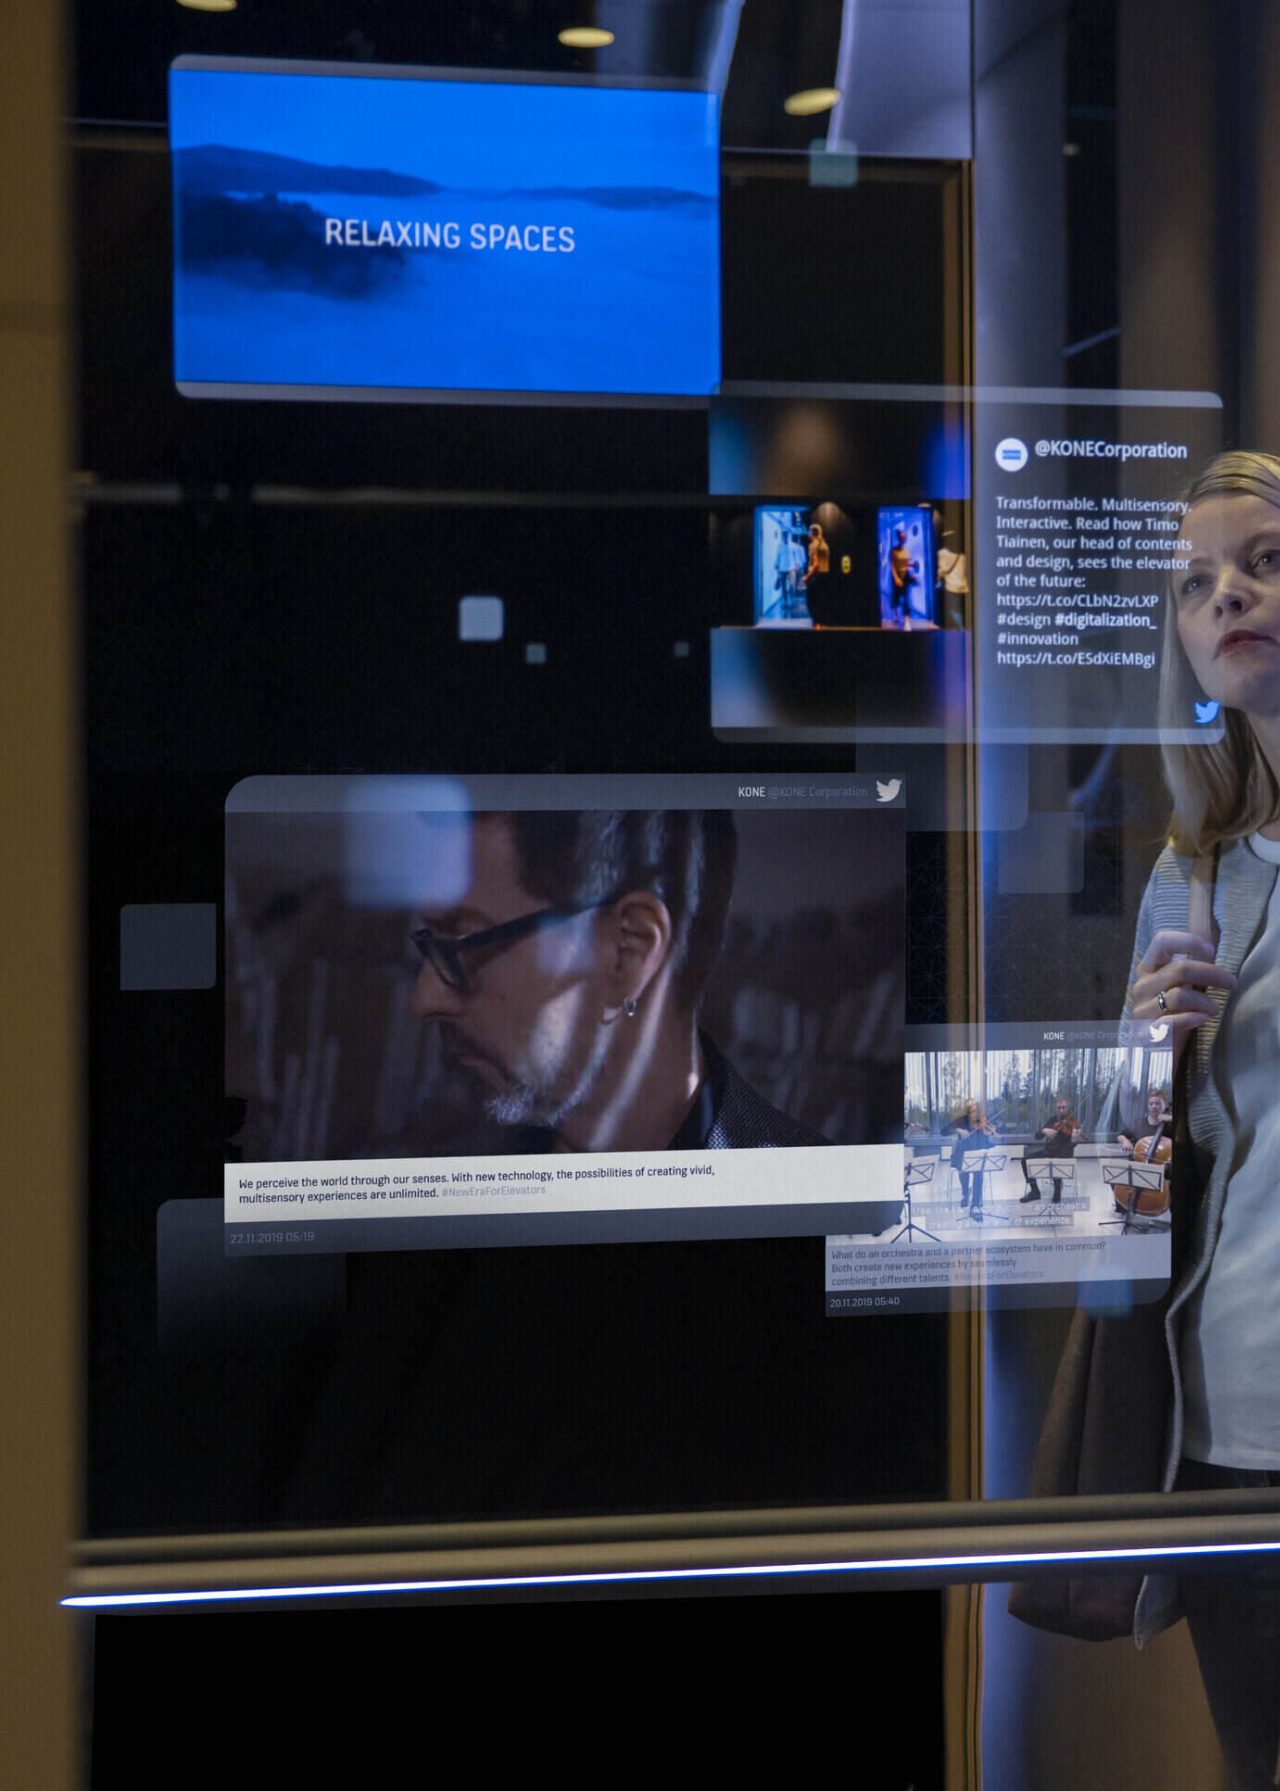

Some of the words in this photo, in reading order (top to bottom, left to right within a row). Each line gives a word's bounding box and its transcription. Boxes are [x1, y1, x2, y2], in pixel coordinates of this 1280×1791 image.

[325, 218, 461, 248] RELAXING
[469, 223, 576, 253] SPACES
[1034, 440, 1188, 461] @KONECorporation
[996, 496, 1098, 511] Transformable.
[1102, 498, 1192, 515] Multisensory.
[996, 516, 1073, 530] Interactive.
[1076, 517, 1110, 530] Read
[1113, 517, 1142, 531] how
[1145, 518, 1179, 531] Timo
[996, 535, 1049, 551] Tiainen,
[1053, 538, 1077, 549] our
[1080, 536, 1114, 549] head
[1117, 537, 1133, 550] of
[1135, 538, 1193, 551] contents
[996, 555, 1023, 568] and
[1026, 555, 1074, 571] design,
[1077, 558, 1108, 569] sees
[1111, 556, 1133, 569] the
[1136, 556, 1191, 570] elevator
[996, 574, 1011, 587] of
[1014, 574, 1037, 587] the
[1040, 574, 1086, 588] future:
[997, 612, 1051, 629] #design
[1055, 612, 1158, 630] #digitalization_
[998, 632, 1079, 646] #innovation
[738, 786, 766, 798] KONE
[808, 786, 868, 800] Corporation
[1043, 1031, 1065, 1041] KONE
[239, 1179, 253, 1189] We
[256, 1177, 299, 1190] perceive
[301, 1177, 318, 1187] the
[320, 1175, 348, 1187] world
[350, 1174, 390, 1188] through
[393, 1175, 409, 1184] our
[412, 1174, 449, 1184] senses.
[451, 1172, 472, 1183] With
[475, 1173, 495, 1182] new
[498, 1169, 554, 1183] technology,
[556, 1169, 573, 1179] the
[575, 1167, 633, 1180] possibilities
[635, 1167, 645, 1177] of
[647, 1165, 687, 1179] creating
[690, 1164, 715, 1176] vivid,
[239, 1190, 305, 1204] multisensory
[307, 1189, 368, 1203] experiences
[370, 1190, 387, 1200] are
[389, 1187, 439, 1199] unlimited.
[230, 1232, 283, 1244] 22.11.2019
[832, 1249, 853, 1260] What
[855, 1249, 867, 1259] do
[869, 1250, 879, 1258] an
[881, 1248, 922, 1258] orchestra
[925, 1247, 941, 1257] and
[1033, 1243, 1054, 1252] have
[1055, 1242, 1064, 1251] in
[832, 1263, 852, 1273] Both
[854, 1263, 882, 1272] create
[884, 1263, 902, 1271] new
[904, 1261, 956, 1272] experiences
[958, 1259, 968, 1269] by
[832, 1275, 877, 1287] combining
[879, 1274, 916, 1285] different
[830, 1298, 872, 1308] 20.11.2019
